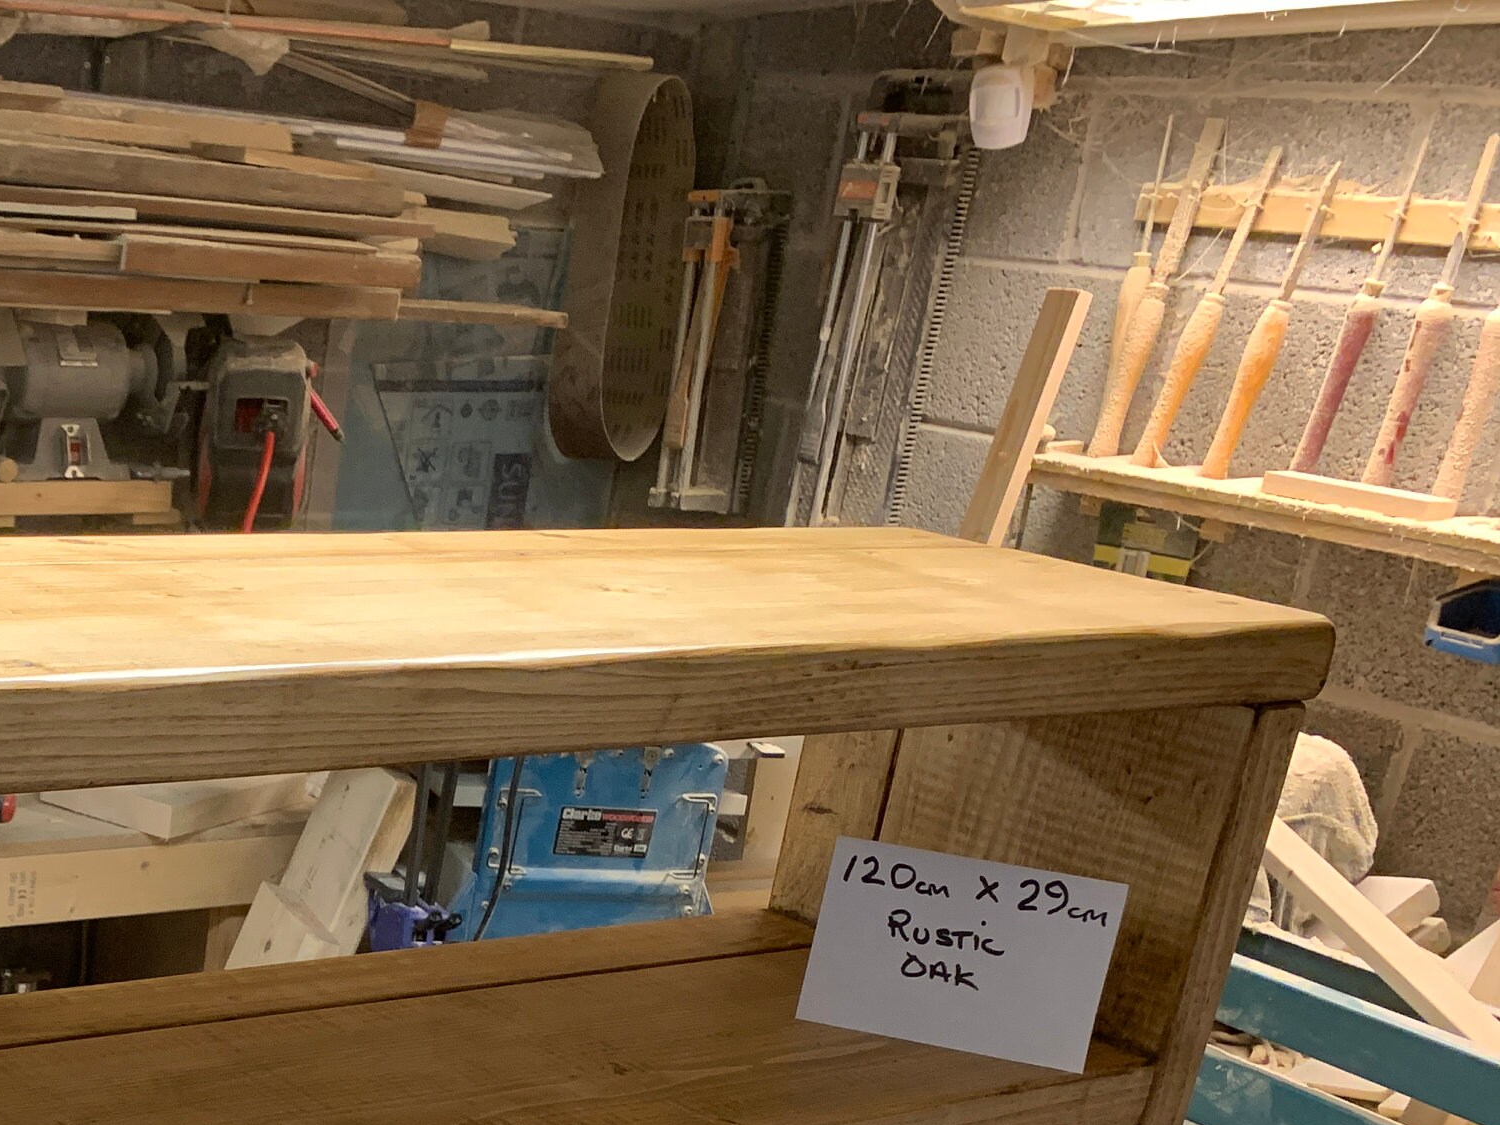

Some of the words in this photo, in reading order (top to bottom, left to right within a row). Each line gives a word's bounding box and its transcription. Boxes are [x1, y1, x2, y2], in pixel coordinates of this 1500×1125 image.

[842, 854, 951, 899] 120cm
[1016, 878, 1108, 928] 29cm
[900, 951, 980, 992] OAK
